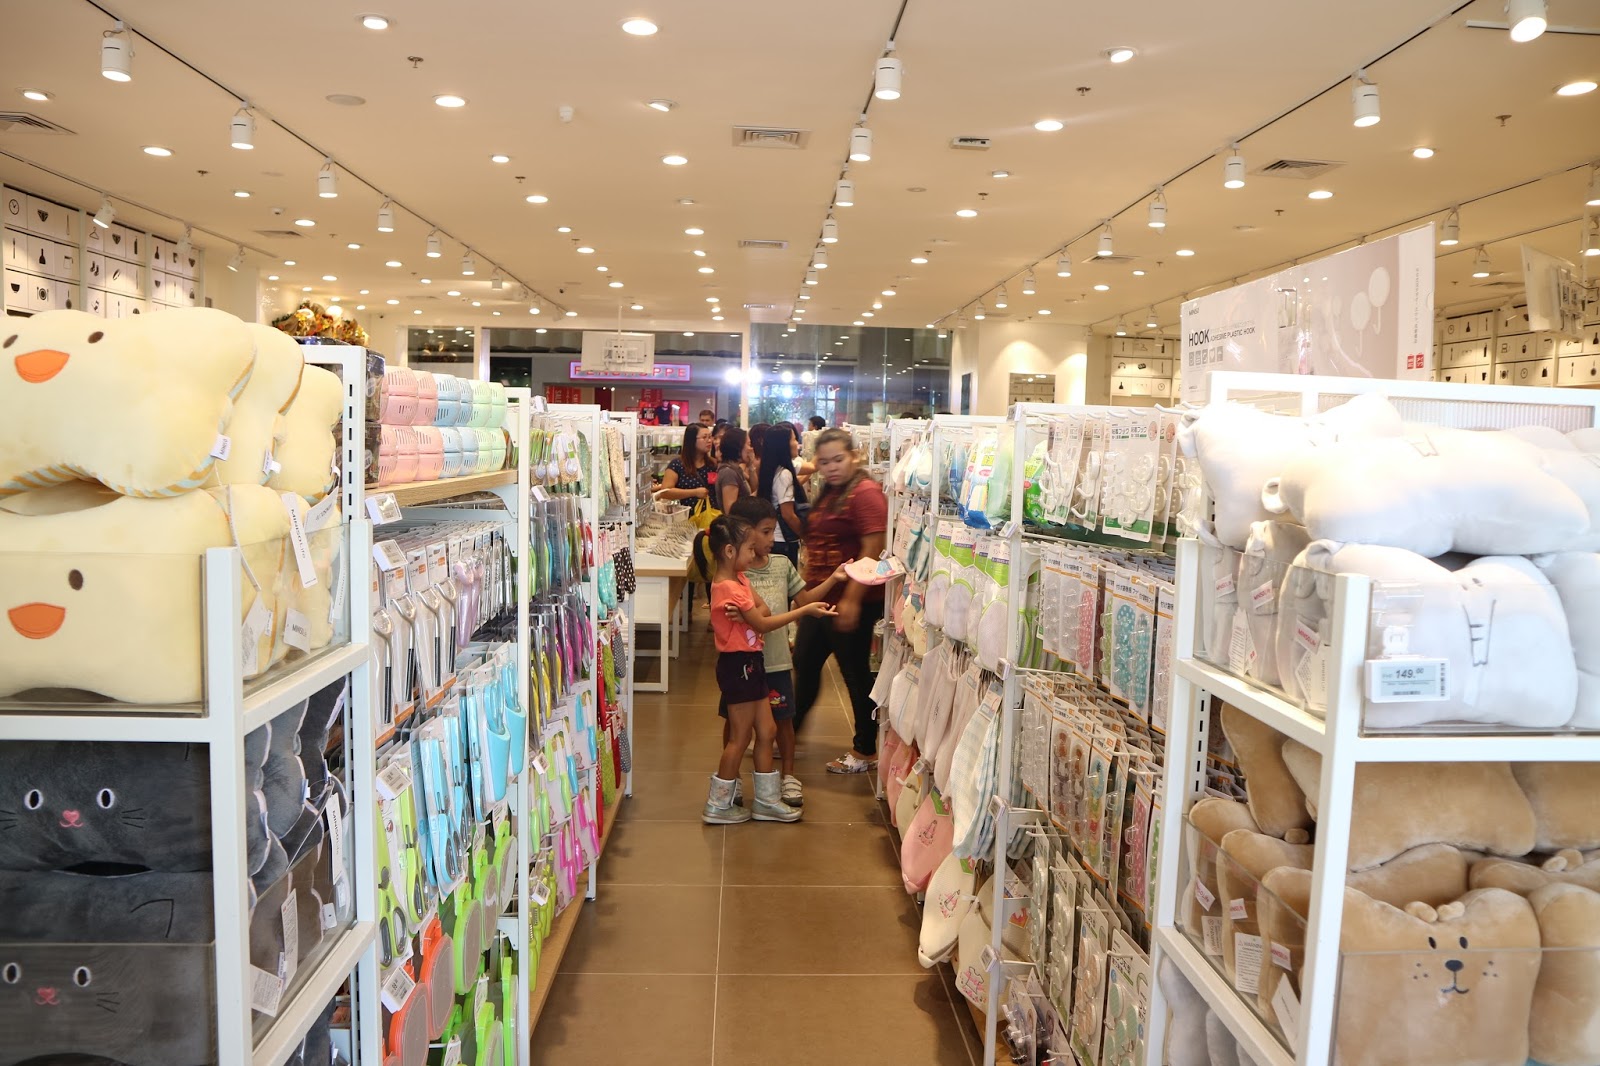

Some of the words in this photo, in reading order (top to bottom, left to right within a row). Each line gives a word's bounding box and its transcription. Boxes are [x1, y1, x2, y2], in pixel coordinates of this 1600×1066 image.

[1188, 328, 1210, 347] HOOK
[1227, 329, 1243, 338] PLASTIC
[1243, 326, 1256, 335] HOOK
[291, 508, 302, 542] MINISO
